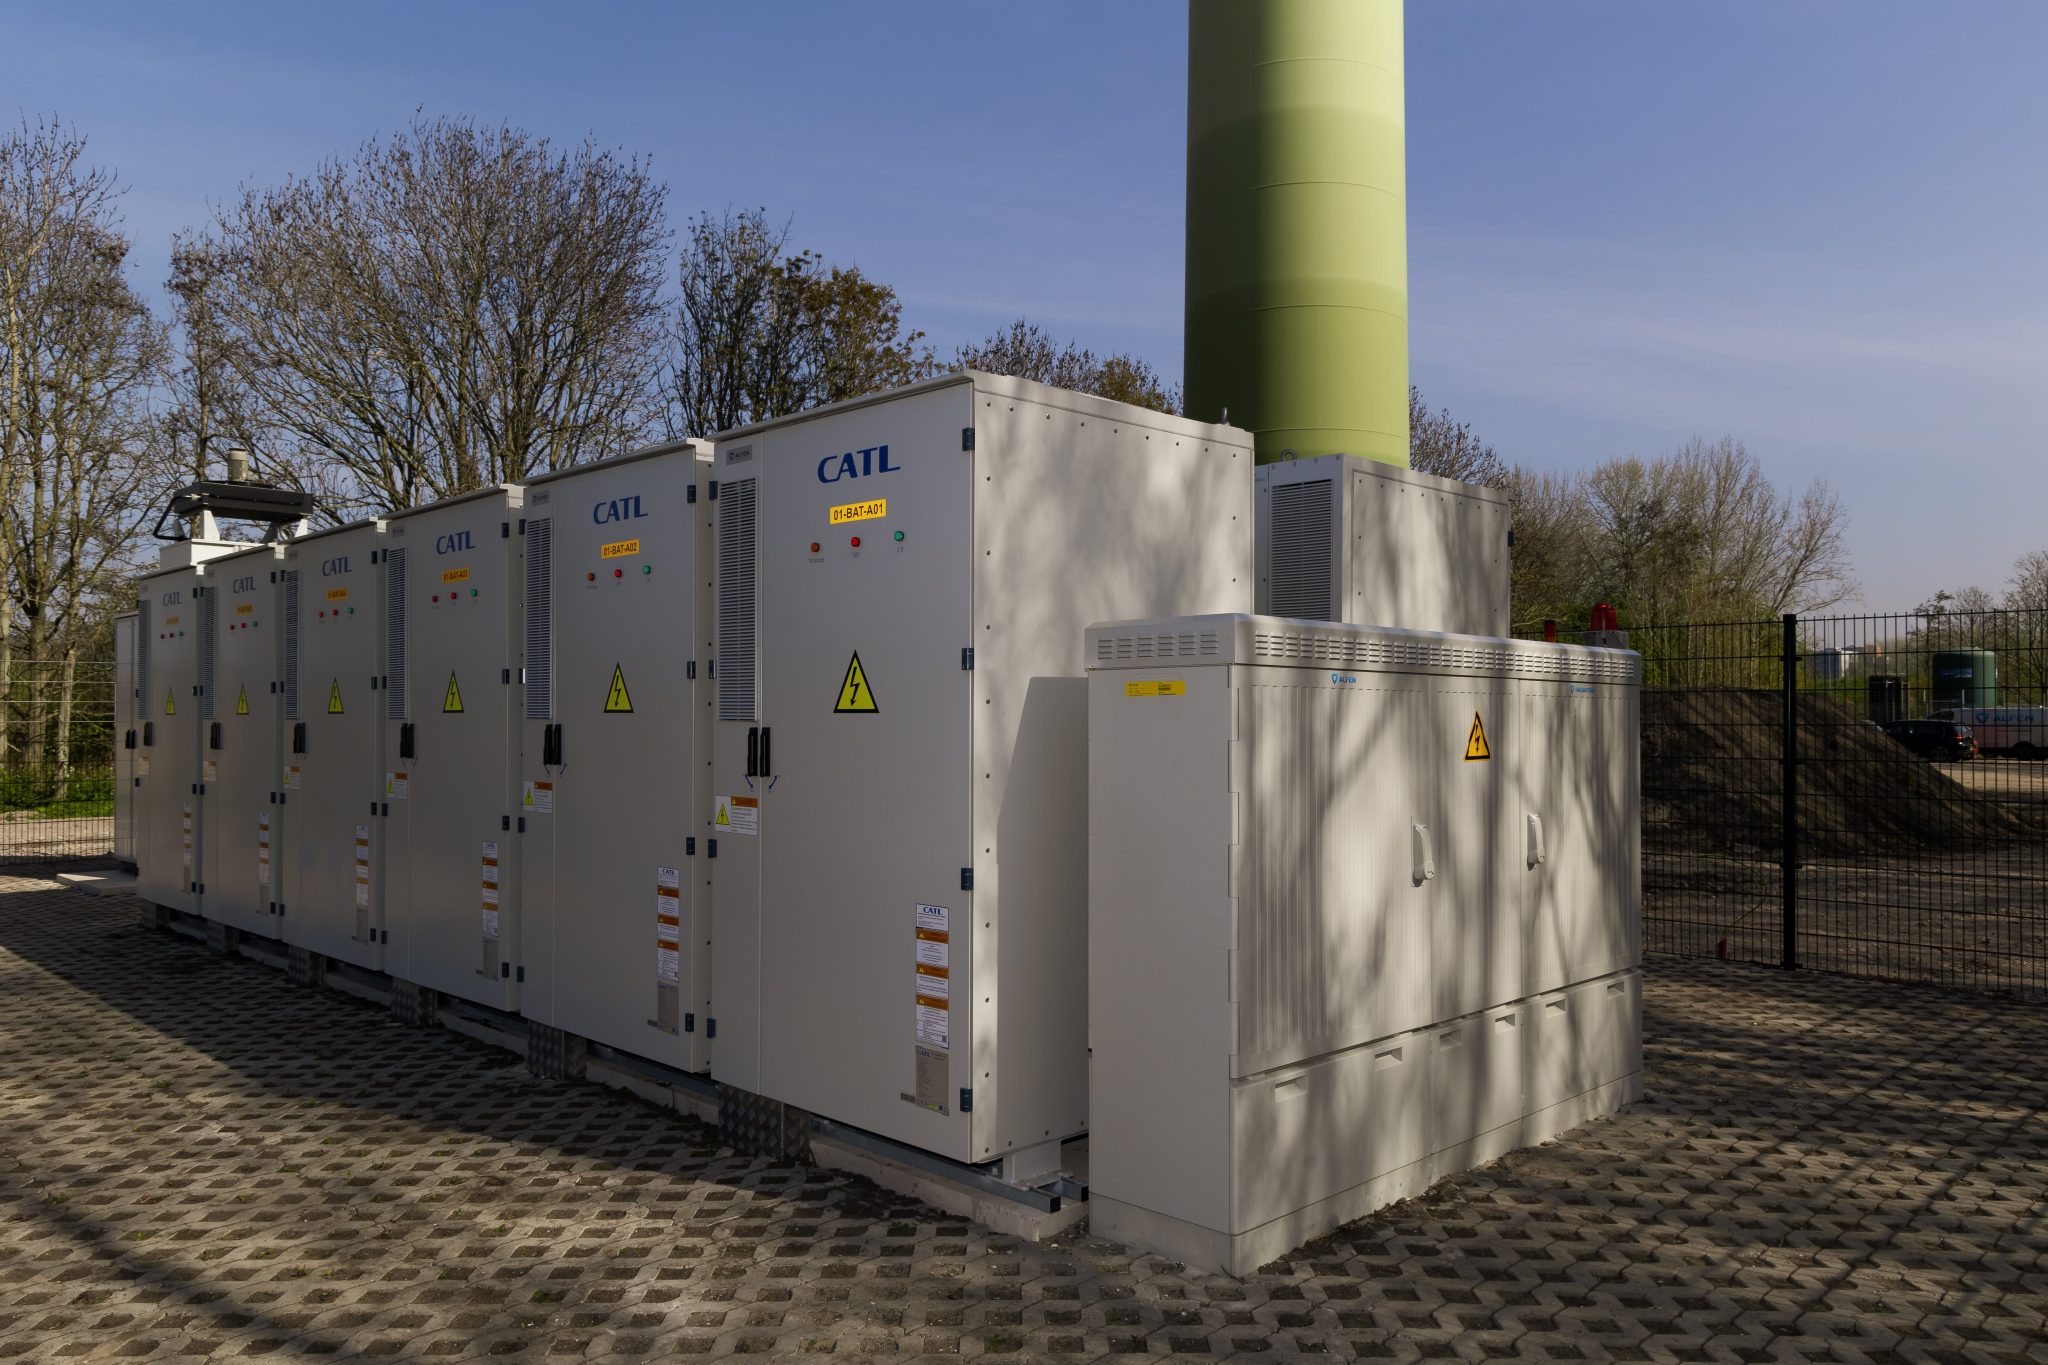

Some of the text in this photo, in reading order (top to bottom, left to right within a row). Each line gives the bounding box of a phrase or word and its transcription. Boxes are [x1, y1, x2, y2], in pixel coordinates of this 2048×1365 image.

[817, 444, 901, 483] CATL
[593, 495, 648, 525] CATL
[833, 503, 884, 521] 01-BAT-A01
[436, 530, 476, 555] CATL
[603, 542, 637, 557] 01-BAT-A02
[322, 556, 352, 577] CATL
[233, 576, 256, 594] CATL
[163, 591, 182, 606] CATL
[1994, 713, 2034, 721] ALFEN
[923, 906, 943, 916] CATL
